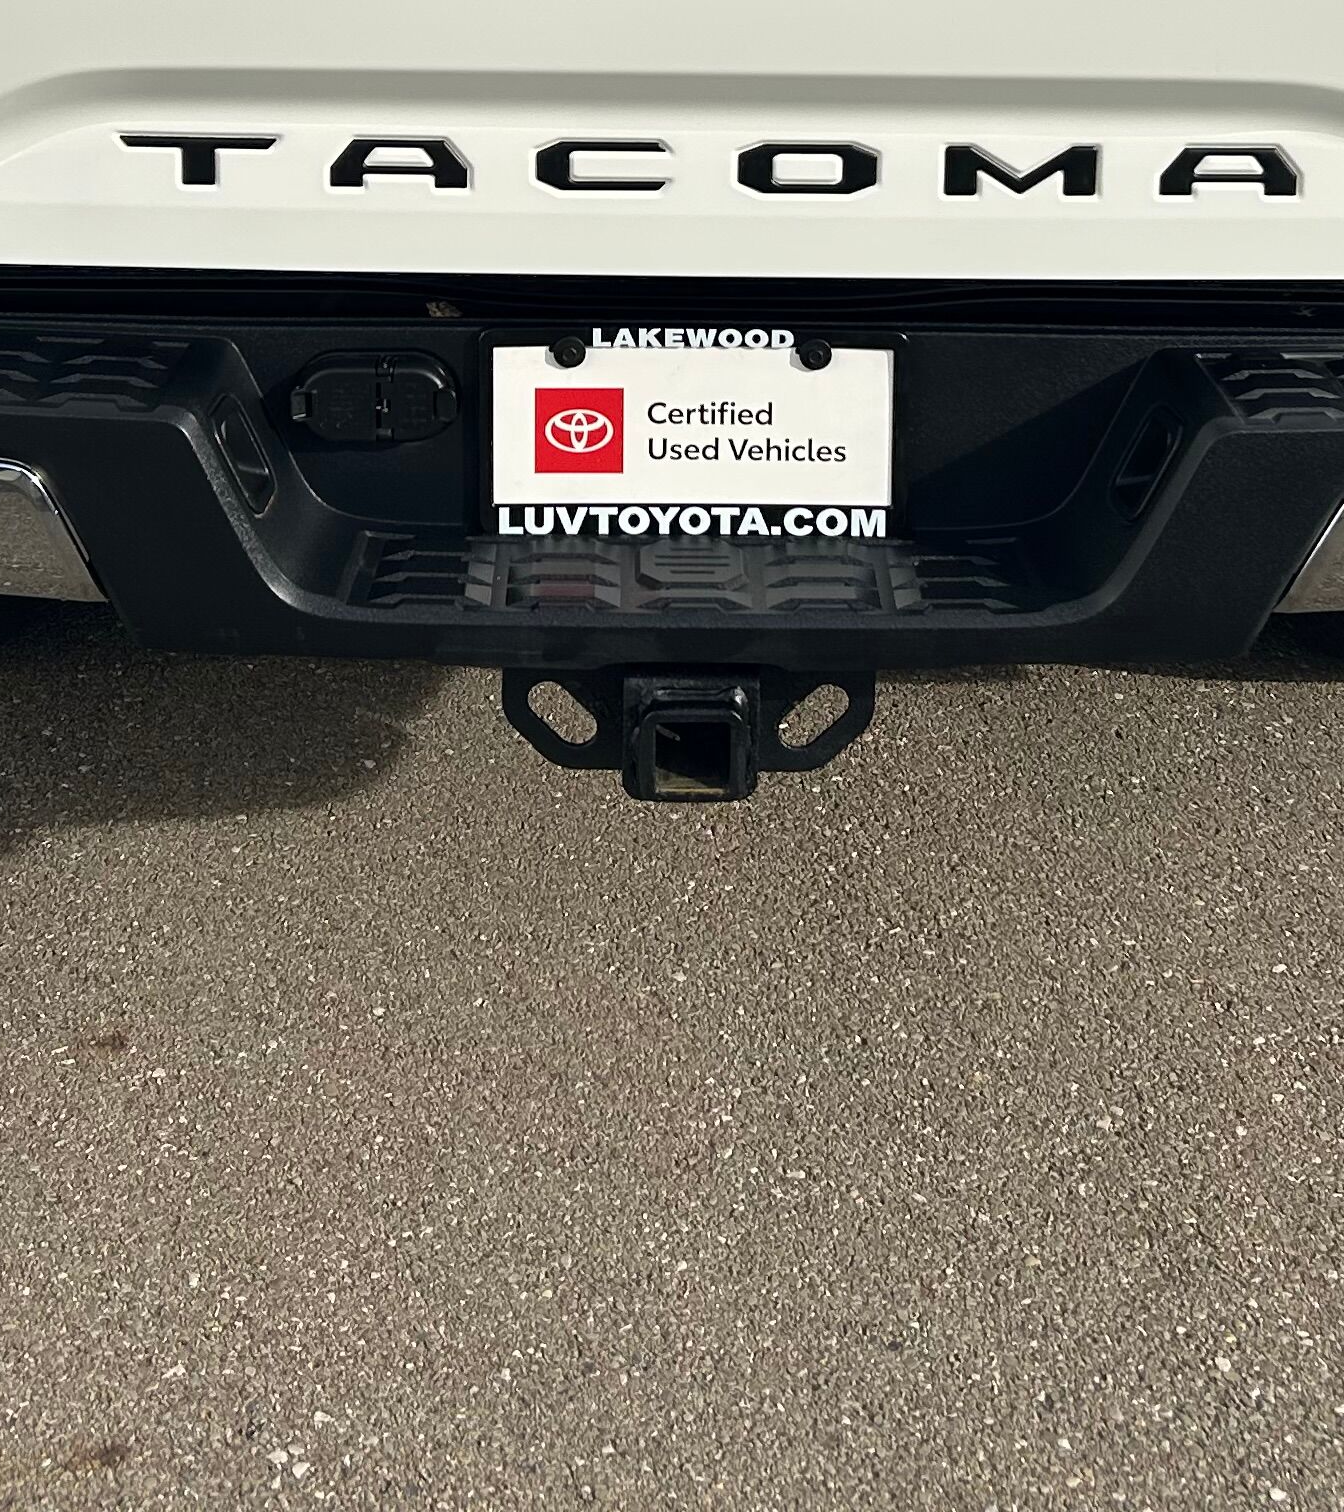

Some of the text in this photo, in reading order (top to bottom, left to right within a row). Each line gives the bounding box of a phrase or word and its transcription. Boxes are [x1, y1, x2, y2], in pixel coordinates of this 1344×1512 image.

[118, 133, 1300, 197] TACOMA
[592, 327, 794, 349] LAKEWOOD
[647, 402, 773, 426] Certified
[648, 438, 847, 462] Used Vehicles
[498, 506, 886, 537] LUVTOYOTA.COM
